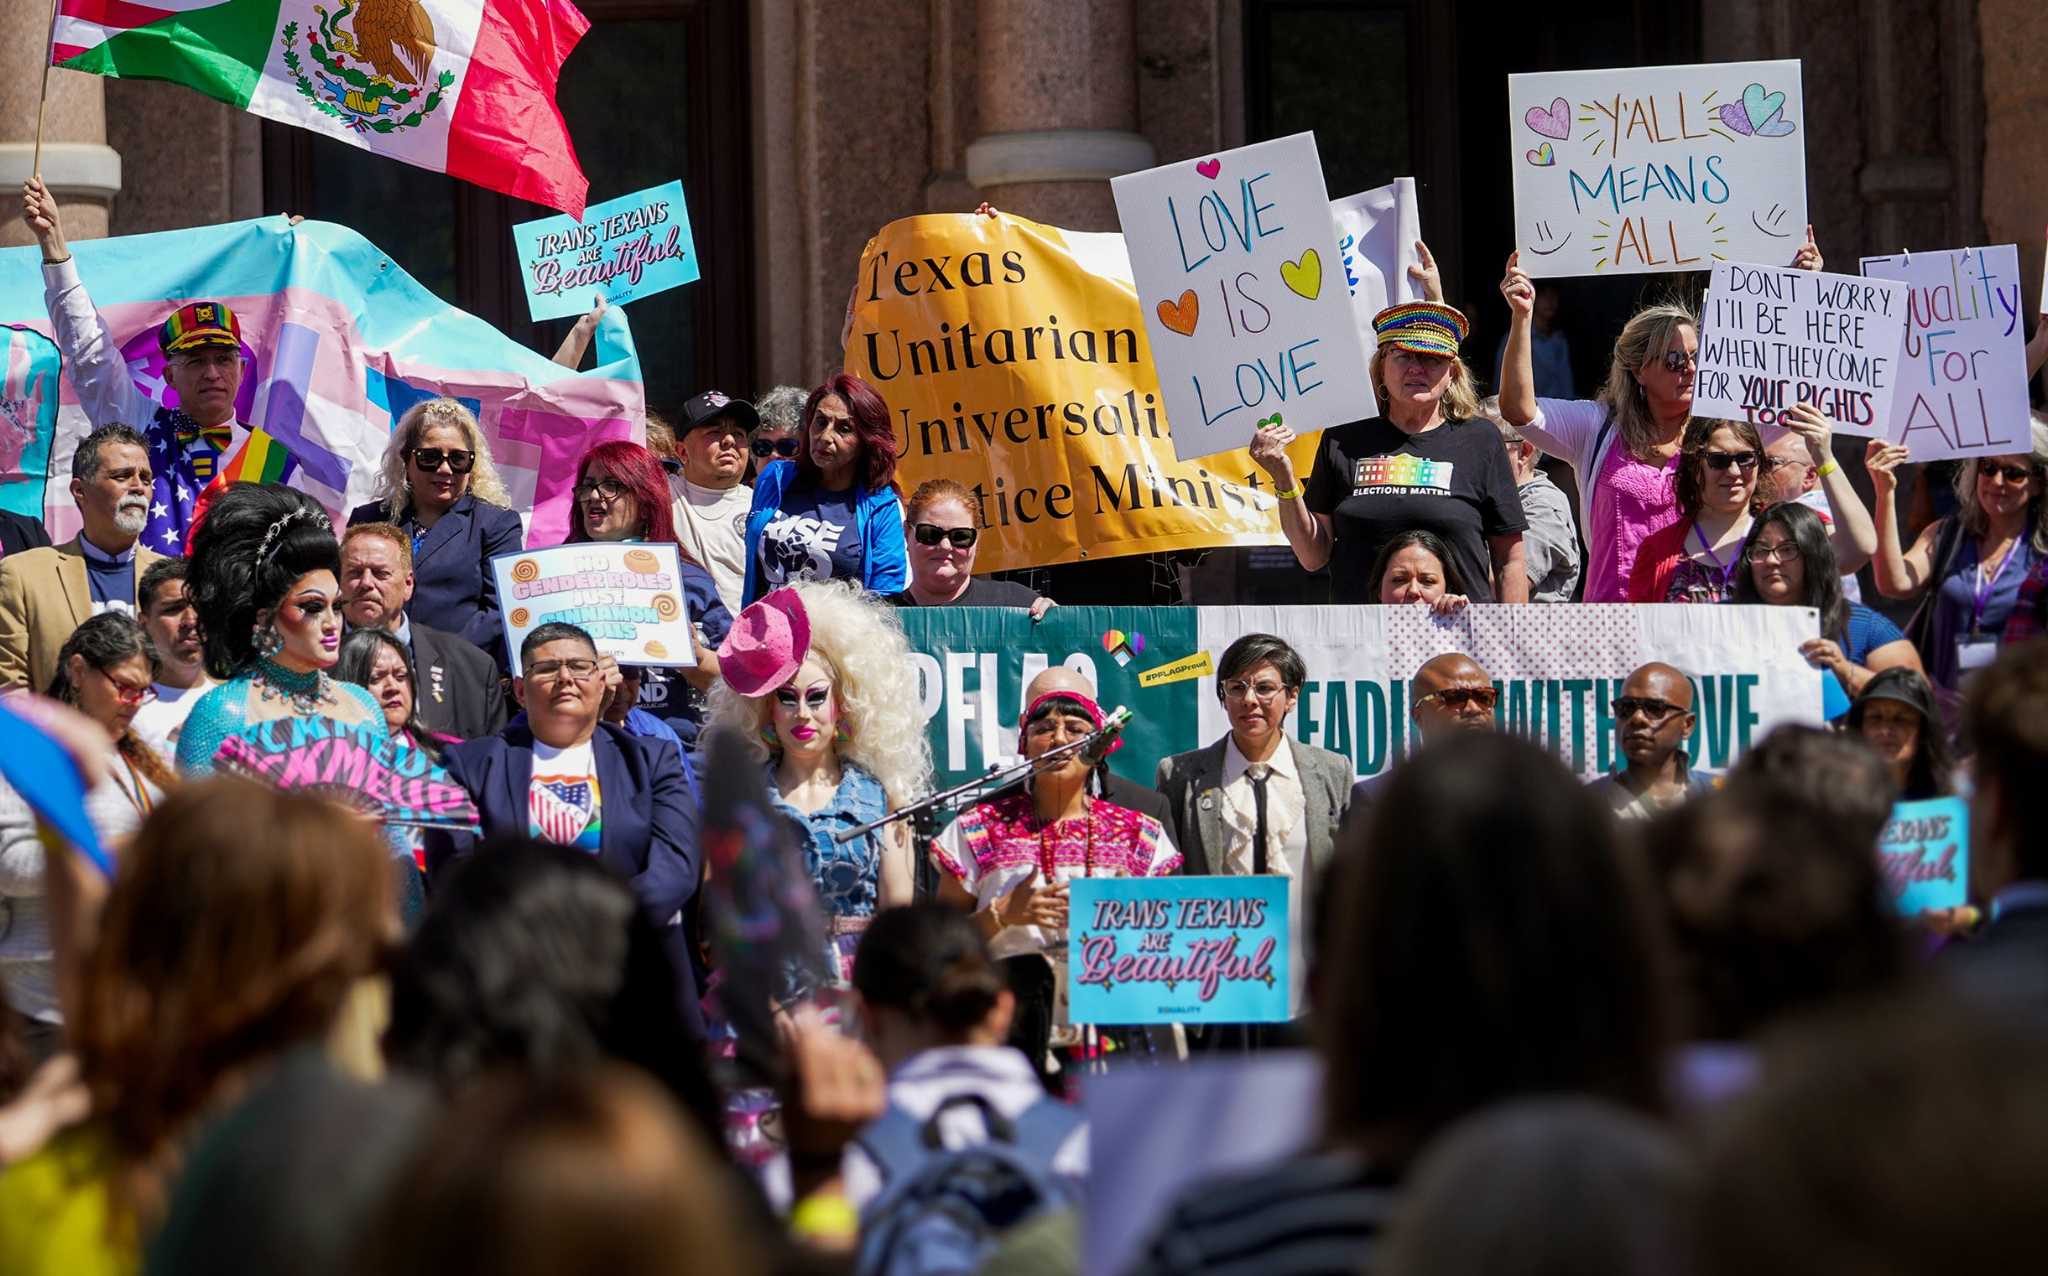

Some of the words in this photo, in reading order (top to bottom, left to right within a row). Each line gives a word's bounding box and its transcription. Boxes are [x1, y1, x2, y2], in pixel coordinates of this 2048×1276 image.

[1593, 91, 1709, 159] Y'ALL
[1569, 155, 1730, 215] MEANS
[536, 224, 597, 258] TRANS
[600, 201, 669, 242] TEXANS
[1168, 172, 1285, 273] LOVE
[1614, 216, 1702, 266] ALL
[532, 224, 681, 295] Beautiful
[577, 246, 602, 266] ARE
[867, 250, 1026, 302] Texas
[1220, 272, 1271, 337] IS
[1730, 266, 1801, 303] DONT
[863, 315, 1140, 381] Unitarian
[1757, 303, 1788, 336] BE
[1806, 310, 1865, 349] HERE
[1193, 339, 1324, 426] LOVE
[1704, 334, 1767, 371] WHEN
[1772, 343, 1823, 380] THEY
[1827, 347, 1887, 389] COME
[1926, 330, 1989, 386] For
[1698, 370, 1733, 401] FOR
[1796, 381, 1874, 427] RIGHTS
[1740, 404, 1794, 427] TOO
[1900, 388, 2012, 450] ALL
[1088, 464, 1275, 520] Minist
[1353, 486, 1407, 497] ELECTIONS
[512, 573, 605, 600] GENDER
[607, 572, 672, 591] ROLES
[574, 554, 609, 572] NO
[539, 606, 660, 625] CINNAMON
[573, 588, 624, 607] JUST
[1092, 899, 1172, 930] TRANS
[1175, 898, 1268, 930] TEXANS
[1077, 935, 1277, 1001] Beautiful
[1138, 932, 1174, 953] ARE
